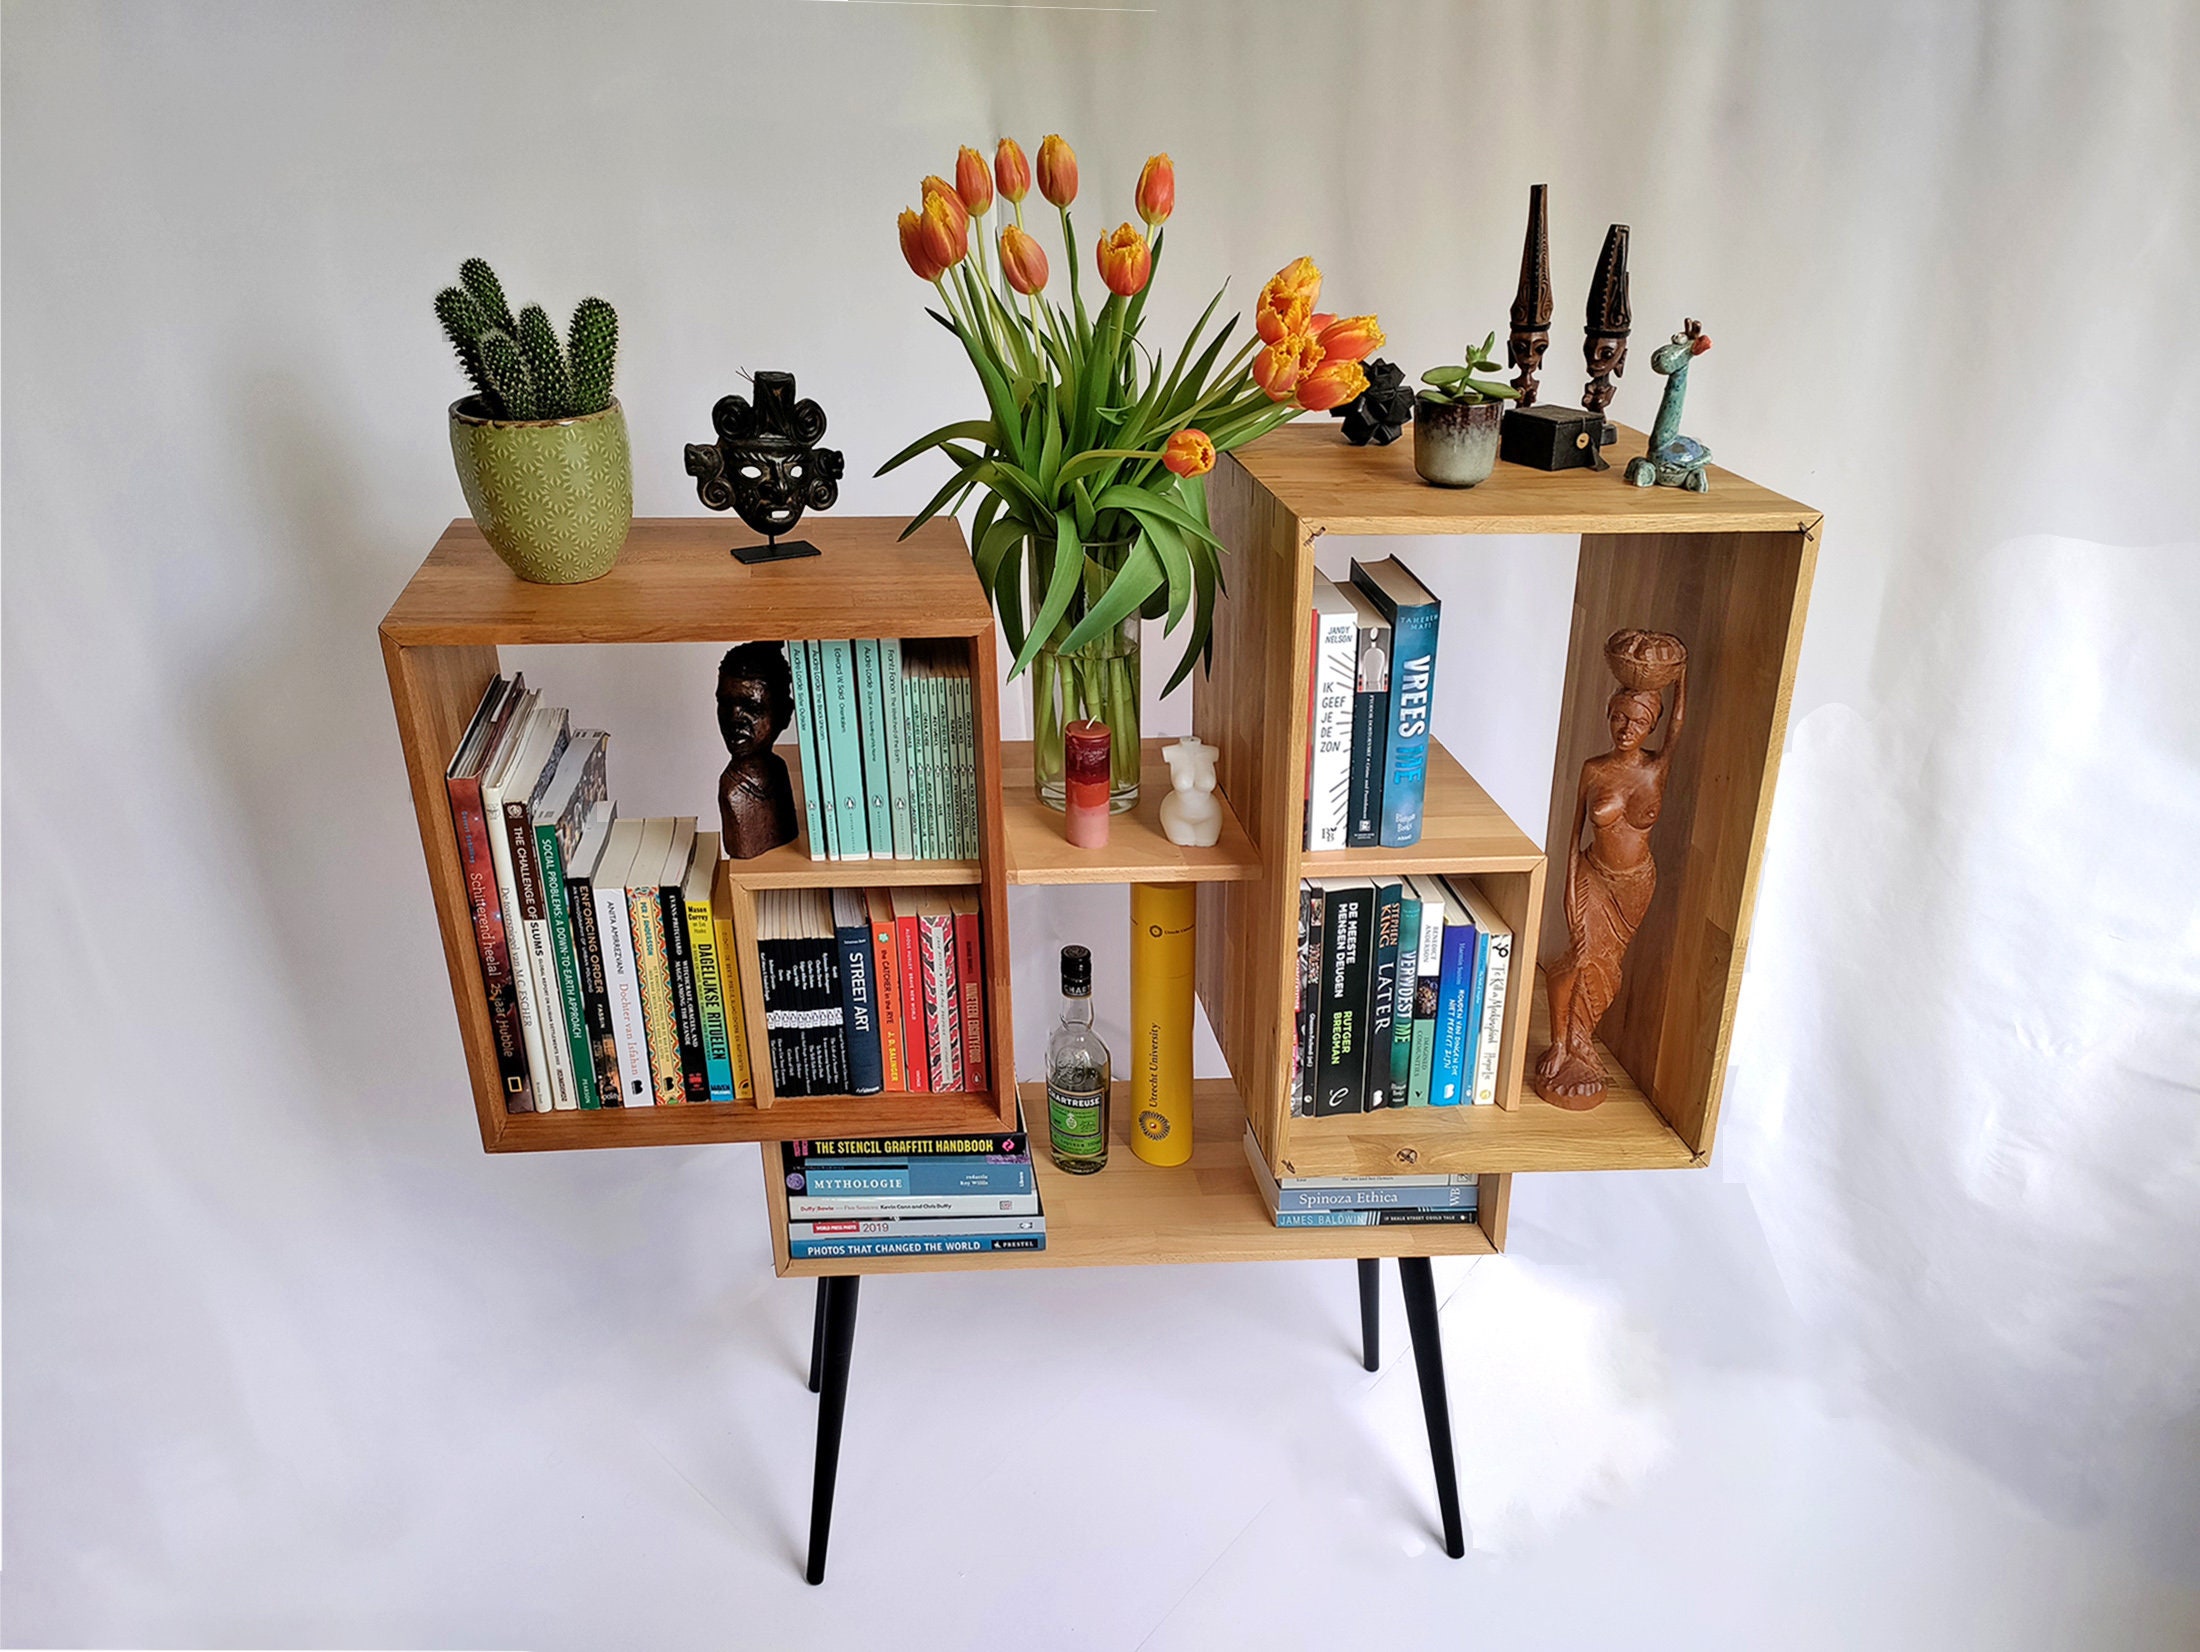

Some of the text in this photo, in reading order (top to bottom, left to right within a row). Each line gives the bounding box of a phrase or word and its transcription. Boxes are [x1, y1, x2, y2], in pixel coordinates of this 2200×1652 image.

[1328, 626, 1350, 635] JANDY
[1401, 614, 1438, 624] TAHEREH
[1325, 635, 1353, 644] NELSON
[834, 648, 842, 674] Edward
[864, 647, 874, 688] Audre Lorde
[814, 672, 822, 691] Lorde
[1323, 682, 1334, 693] IK
[1398, 655, 1430, 738] VREES
[1321, 696, 1346, 708] GEEF
[1321, 712, 1333, 723] JE
[1320, 727, 1332, 738] DE
[1320, 741, 1341, 752] ZON
[1393, 745, 1424, 786] ME
[542, 839, 558, 869] SOCIAL
[513, 826, 538, 920] THE CHALLENGE OF
[547, 871, 563, 918] PROBLEMS:
[529, 922, 544, 956] SLUMS
[579, 885, 604, 993] ENFORCING ORDER
[607, 901, 624, 974] ANITA AMIRREZVANI
[669, 895, 683, 955] EVANS-PRITCHARD
[1346, 902, 1358, 964] DE MEESTE
[1378, 904, 1391, 948] KING
[1390, 902, 1400, 946] STEPHEN
[501, 887, 510, 899] De
[513, 952, 522, 967] van
[518, 990, 533, 1027] ESCHER
[1334, 904, 1348, 998] MENSEN DEUGEN
[1423, 924, 1431, 963] ANDERSON
[1431, 926, 1439, 960] BENEDICT
[470, 872, 493, 940] Schitterend
[482, 942, 501, 976] heelal
[498, 1020, 514, 1057] Hubble
[556, 927, 575, 995] DOWN-TO-EARTH
[675, 961, 684, 983] MAGIC
[698, 944, 719, 1007] DAGELIJKSE
[849, 952, 867, 1003] STREET
[882, 960, 892, 992] CATCHER
[677, 984, 687, 1006] AMONG
[1375, 962, 1394, 1034] LATER
[1394, 950, 1416, 1043] VERWOEST ME
[1457, 989, 1465, 1019] HOUDEN
[566, 996, 582, 1038] APPROACH
[619, 984, 640, 1075] Dochter van Isfahan
[683, 1020, 691, 1046] AZANDE
[854, 1006, 869, 1032] ART
[886, 1011, 894, 1024] RYE
[1341, 1011, 1353, 1053] RUTGER
[1443, 999, 1455, 1069] NIET PERFECT ZIJN
[1455, 1021, 1463, 1035] VAN
[707, 1012, 726, 1060] RITUELEN
[1331, 1012, 1342, 1064] BREGMAN
[1452, 1036, 1461, 1063] DINGEN
[889, 1047, 898, 1082] SALINGER
[1149, 1022, 1161, 1108] Utrecht University
[1414, 1030, 1423, 1077] COMMUNITIES
[582, 1078, 590, 1103] PEARSON
[815, 1139, 994, 1154] THE STENCIL GRAFFITI HANDBOOK
[814, 1178, 903, 1189] MYTHOLOGIE
[1299, 1192, 1398, 1208] Spinoza Ethica
[1450, 1188, 1460, 1206] WB
[863, 1223, 888, 1233] 2019
[1280, 1215, 1366, 1225] JAMES BALDWIN
[808, 1241, 980, 1256] PHOTOS THAT CHANGED THE WORLD
